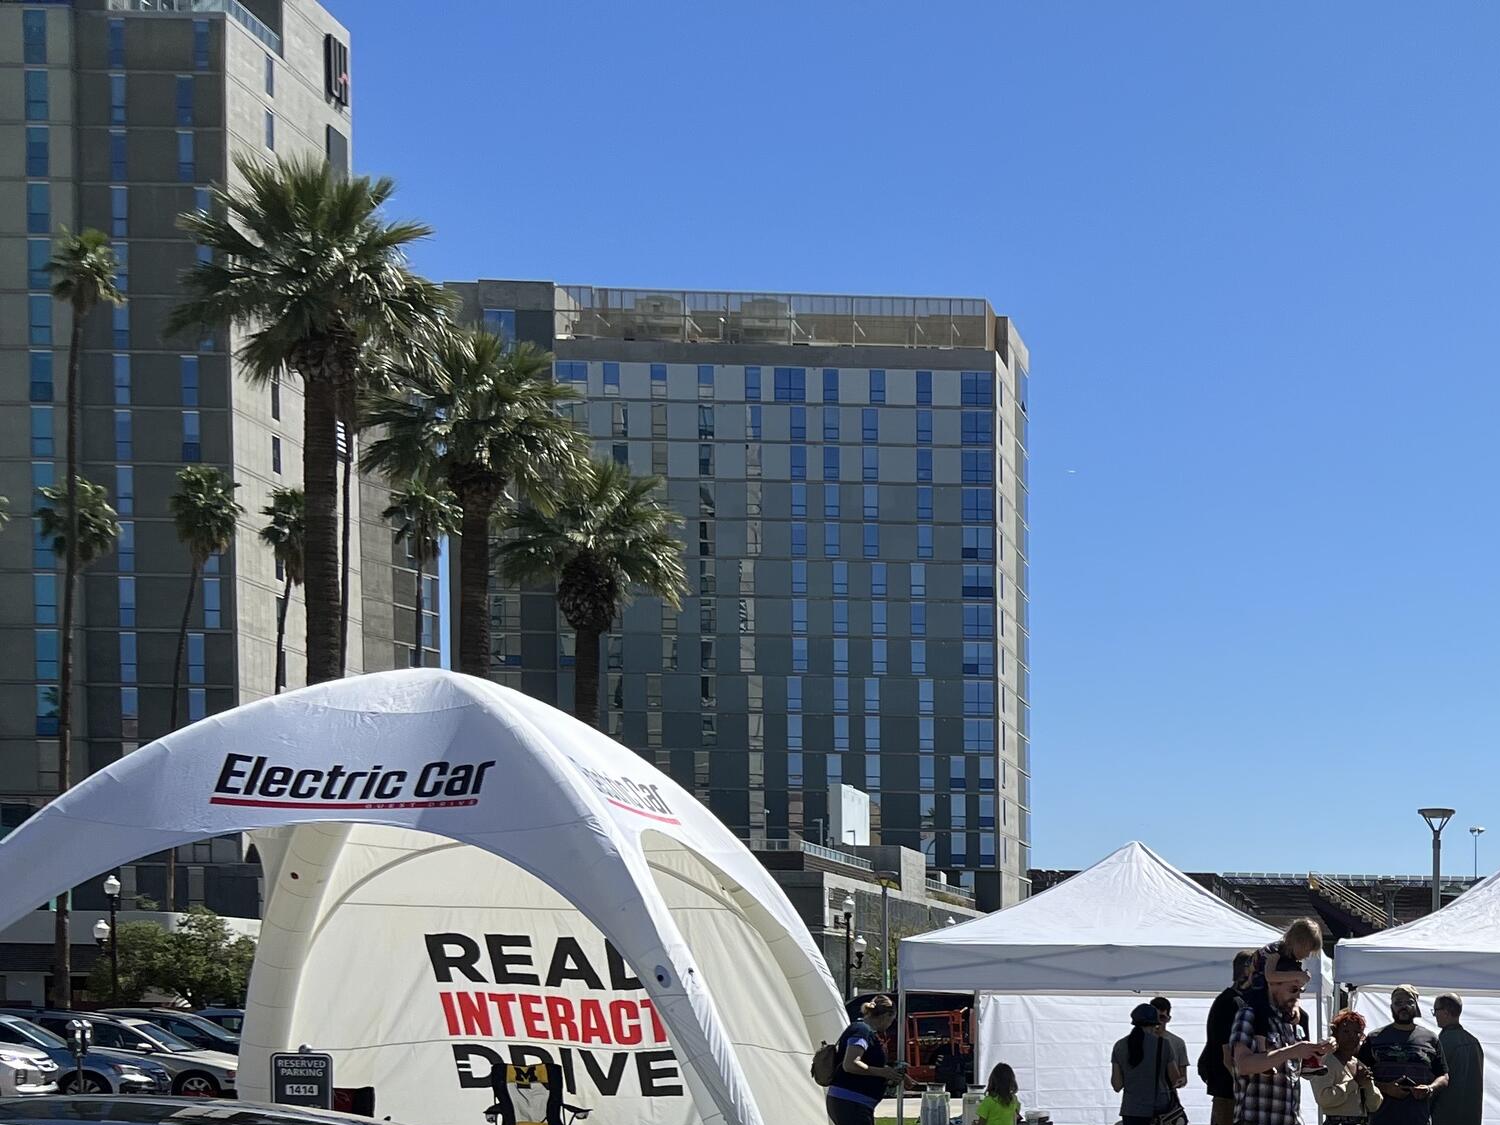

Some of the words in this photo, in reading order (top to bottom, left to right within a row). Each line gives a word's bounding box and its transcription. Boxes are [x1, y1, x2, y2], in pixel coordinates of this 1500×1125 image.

[214, 752, 407, 800] Electric
[414, 760, 496, 798] Car
[439, 991, 669, 1046] INTERACT
[278, 1059, 326, 1068] RESERVED
[281, 1068, 323, 1077] PARKING
[289, 1086, 314, 1094] 1414
